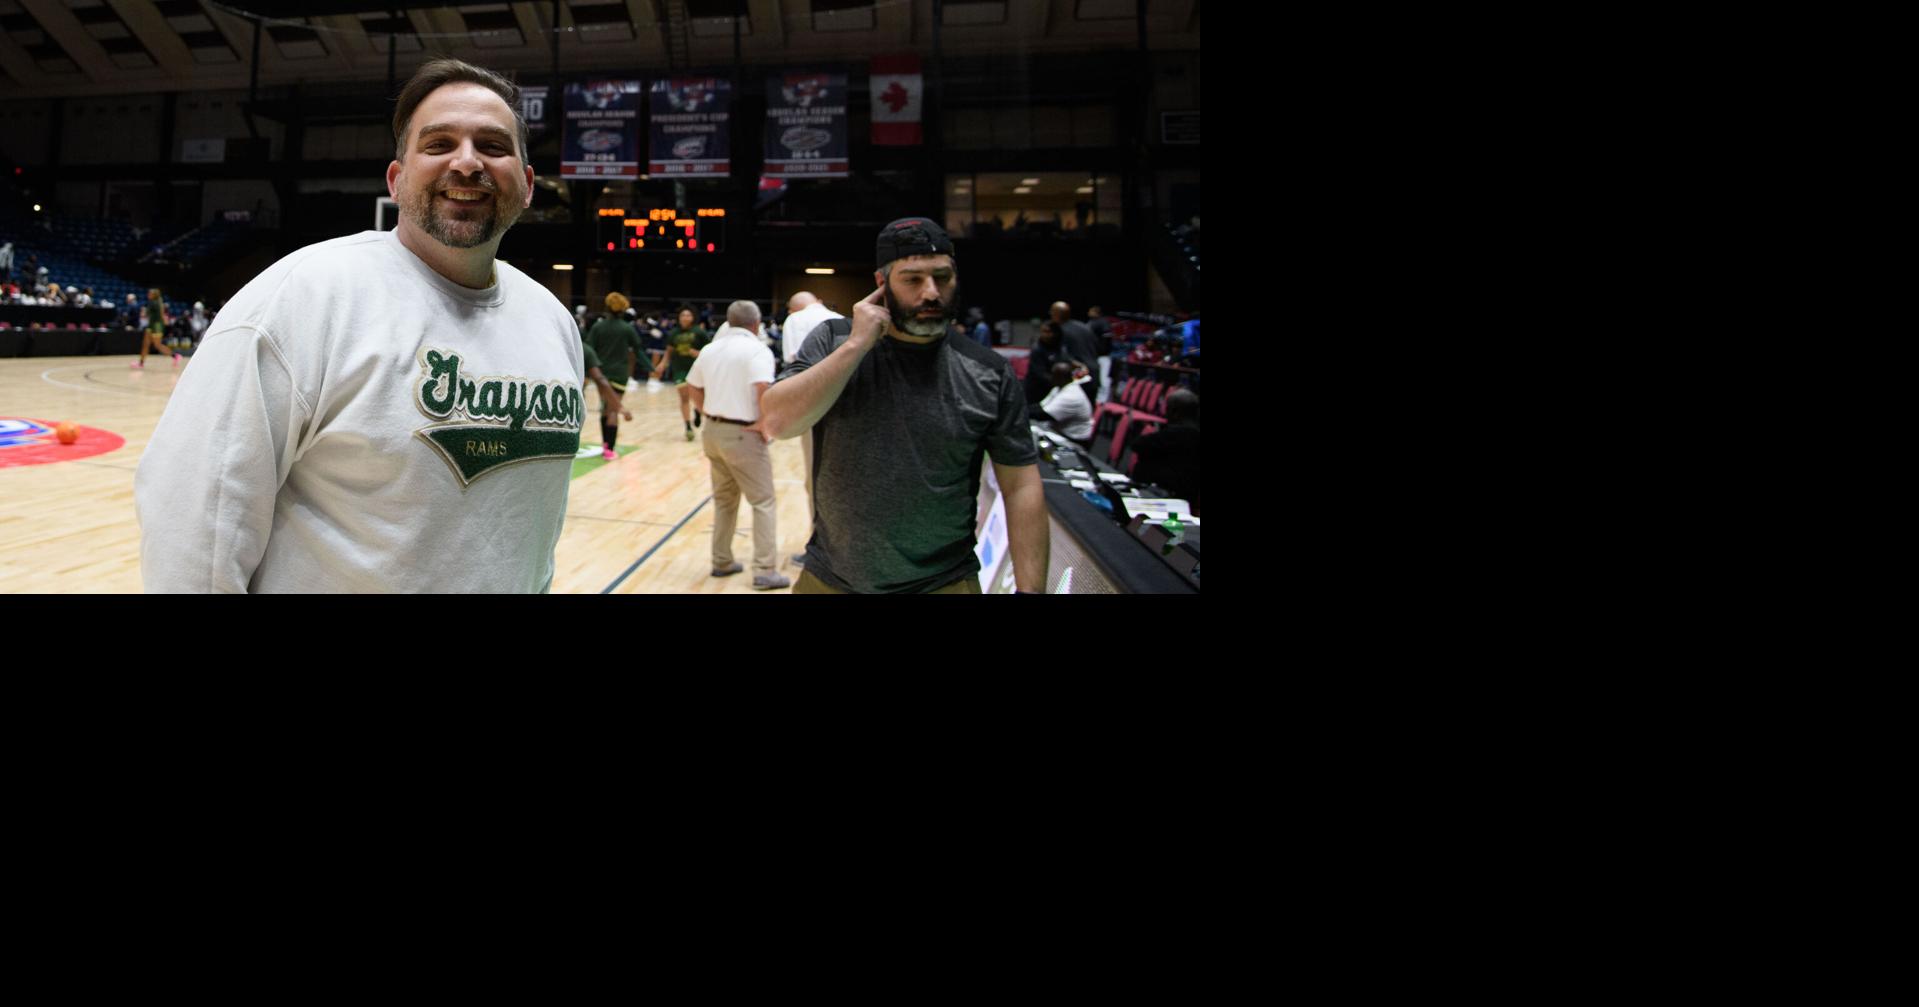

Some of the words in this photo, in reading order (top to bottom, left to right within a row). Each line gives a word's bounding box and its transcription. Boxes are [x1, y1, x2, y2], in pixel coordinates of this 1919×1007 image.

[709, 111, 729, 122] CUP
[421, 348, 581, 431] Grayson
[465, 439, 509, 457] RAMS
